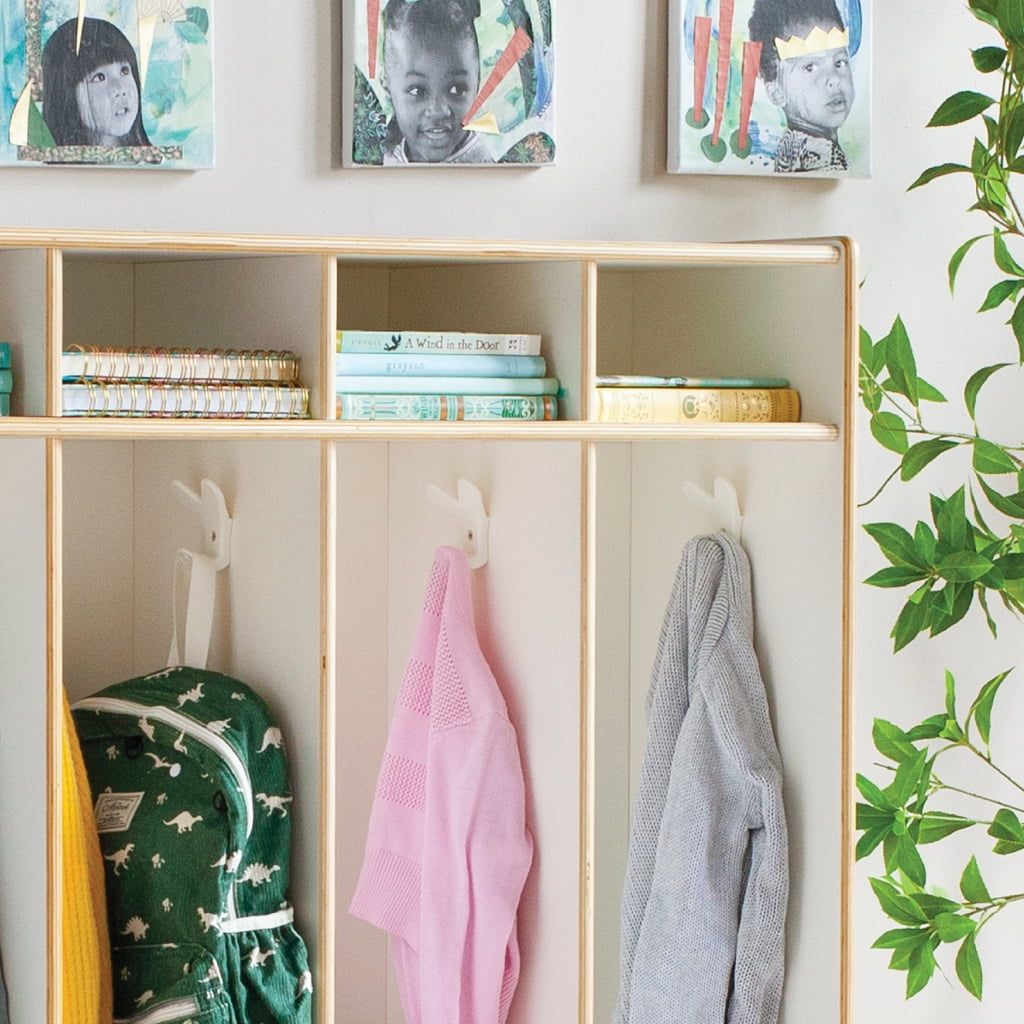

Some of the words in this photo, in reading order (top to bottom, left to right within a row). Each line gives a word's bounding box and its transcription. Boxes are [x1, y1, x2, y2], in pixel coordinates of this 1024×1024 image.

[405, 338, 414, 349] A
[416, 335, 444, 350] Wind
[446, 338, 455, 350] in
[458, 338, 473, 351] the
